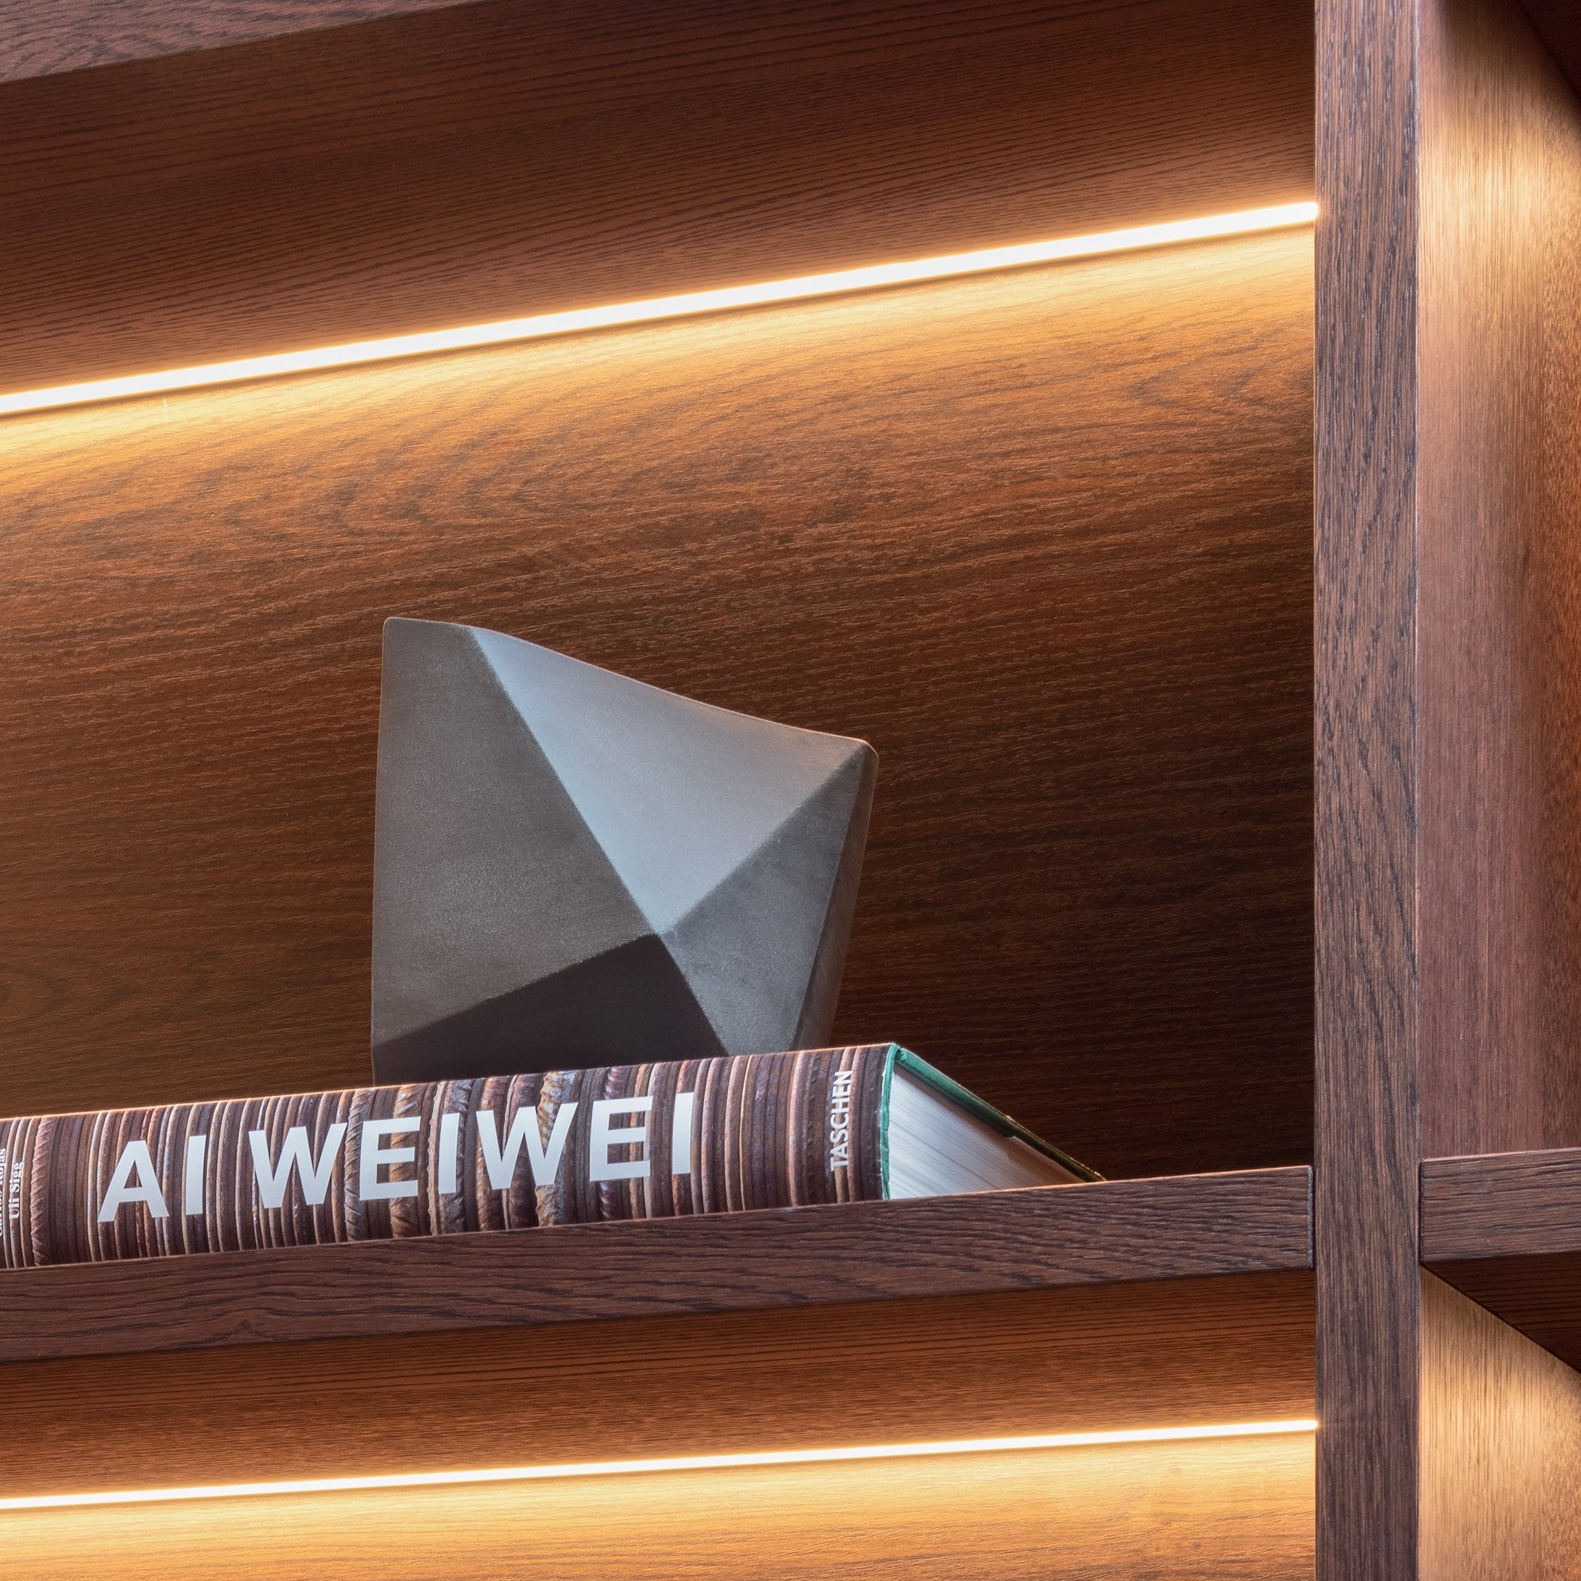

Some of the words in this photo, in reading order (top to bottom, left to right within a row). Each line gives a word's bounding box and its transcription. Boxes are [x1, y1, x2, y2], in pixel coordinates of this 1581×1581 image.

[830, 1071, 853, 1172] TASCHEN
[9, 1162, 24, 1192] Sigg
[97, 1135, 206, 1223] AI
[248, 1092, 695, 1209] WEIWEI
[9, 1195, 19, 1220] Uli
